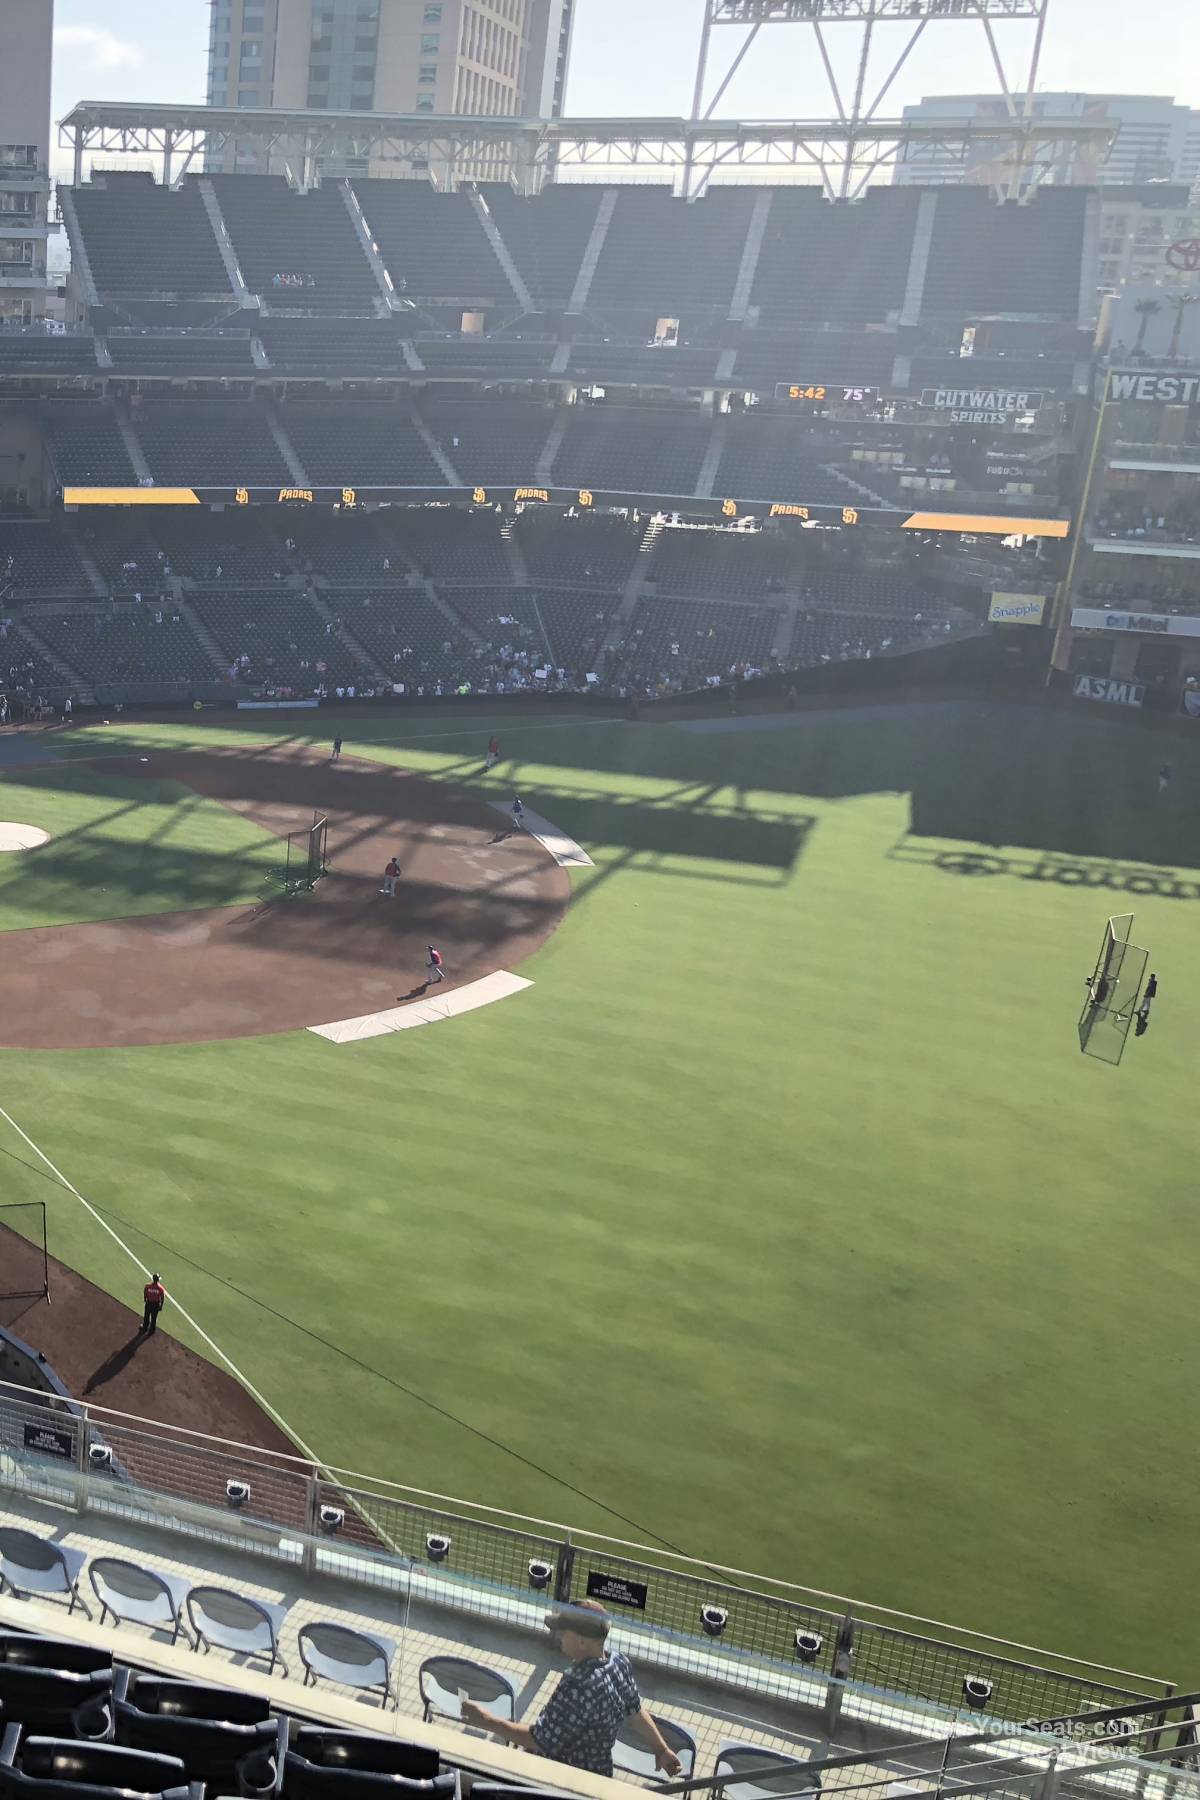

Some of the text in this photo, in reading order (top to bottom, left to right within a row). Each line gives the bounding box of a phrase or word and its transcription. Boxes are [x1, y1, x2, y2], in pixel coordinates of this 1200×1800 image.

[788, 386, 826, 399] 5:42
[1111, 373, 1200, 402] WEST
[935, 391, 1029, 409] CUTWATER
[950, 411, 1007, 424] SPIRITS
[278, 489, 314, 502] PADRES
[514, 488, 549, 502] PADRES
[769, 503, 809, 520] PADRES
[992, 603, 1040, 619] Snapple
[1076, 677, 1141, 705] ASML
